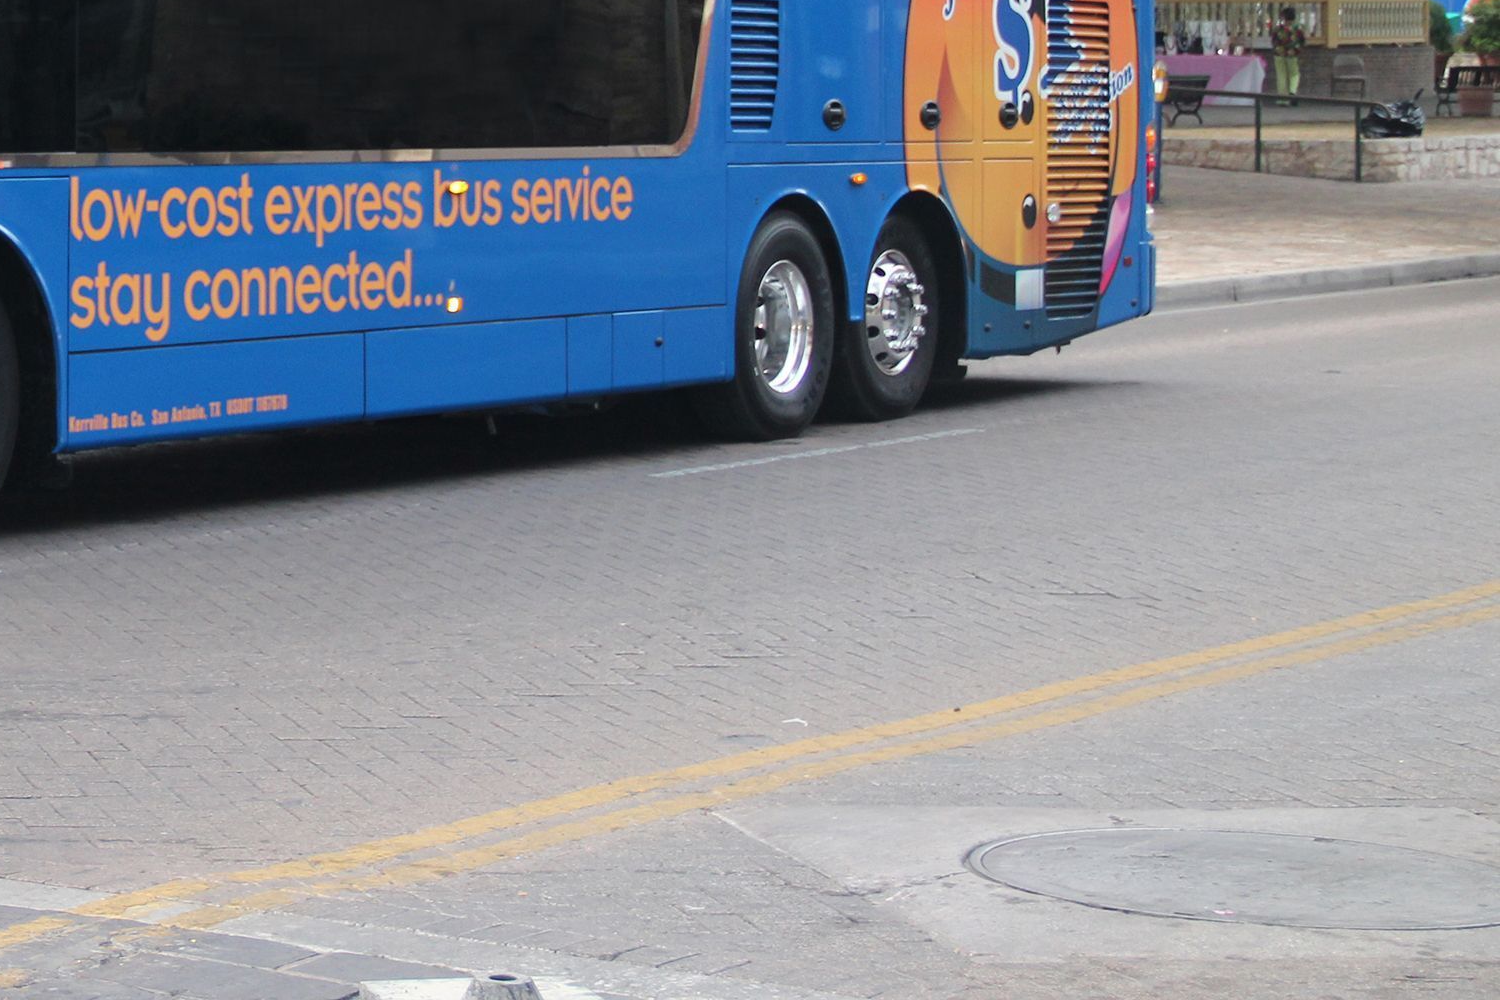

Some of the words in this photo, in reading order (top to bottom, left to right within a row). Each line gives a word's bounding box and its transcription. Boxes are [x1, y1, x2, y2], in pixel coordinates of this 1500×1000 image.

[69, 173, 253, 241] low-cost
[264, 179, 422, 248] express
[433, 168, 502, 227] bus
[510, 165, 633, 224] service
[69, 261, 171, 342] stay
[183, 248, 444, 318] connected...
[68, 414, 109, 432] Kerrville
[151, 408, 169, 425] San
[209, 401, 221, 417] TX
